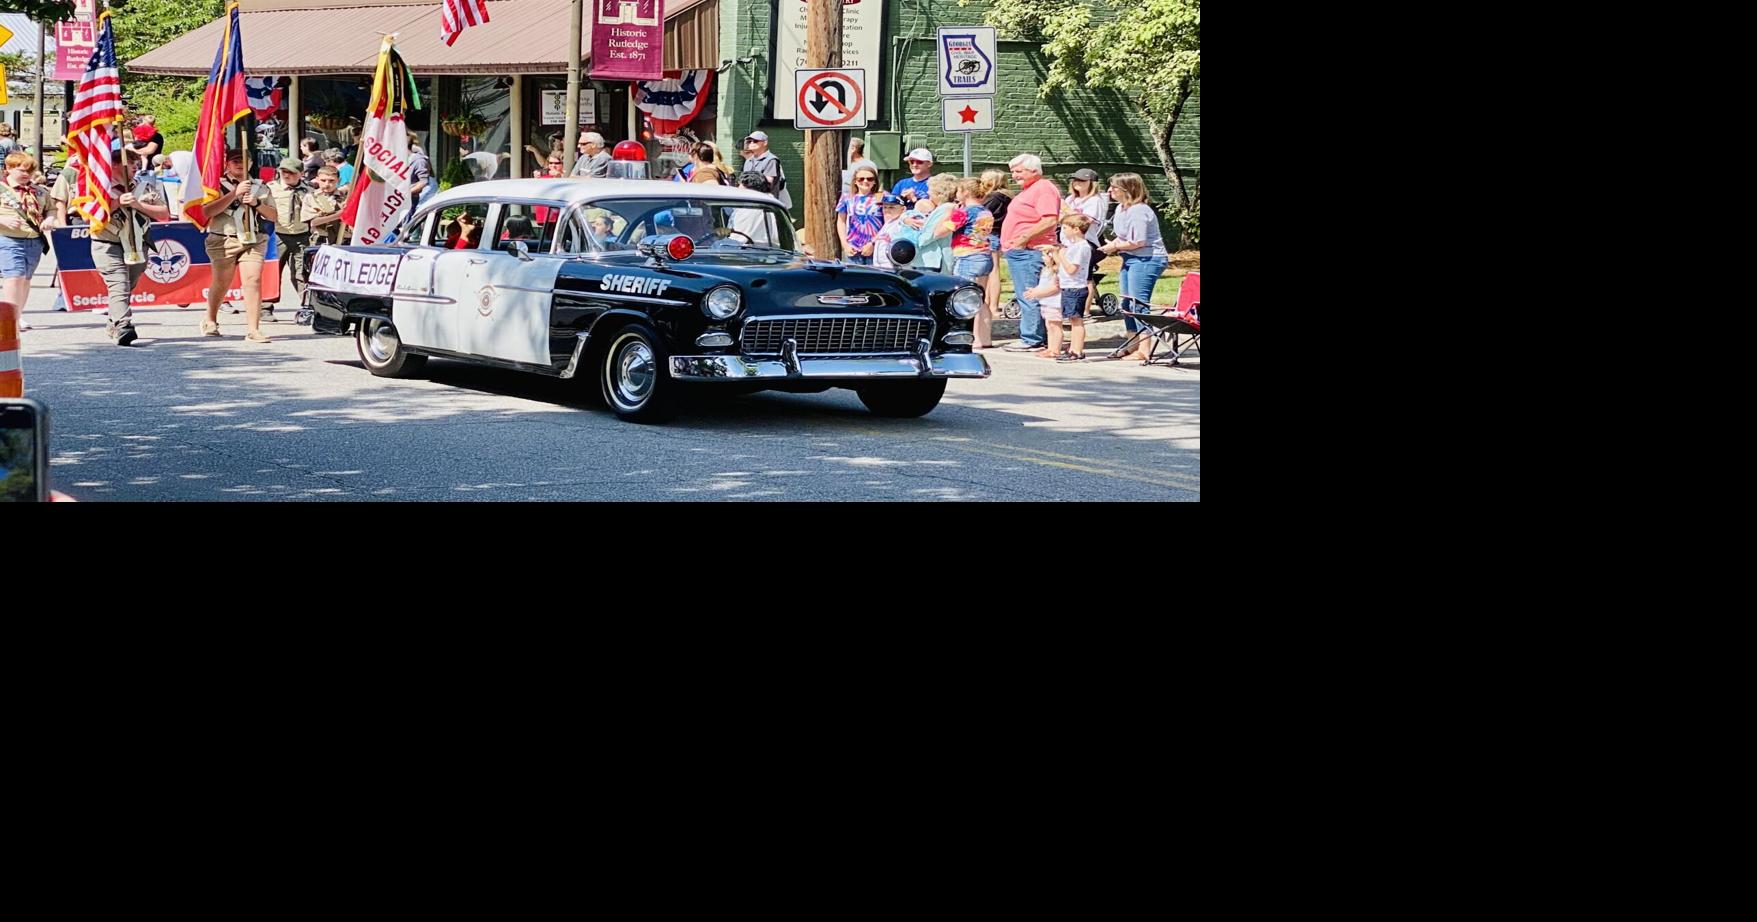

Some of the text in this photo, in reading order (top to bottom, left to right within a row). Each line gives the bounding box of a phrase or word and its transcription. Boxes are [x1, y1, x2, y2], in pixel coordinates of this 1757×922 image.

[611, 27, 648, 38] Historic
[608, 38, 649, 50] Rutledge
[609, 49, 646, 61] Est. 1871
[953, 75, 976, 83] TRAILS
[364, 137, 408, 180] SOCIAL
[71, 228, 89, 239] BO
[600, 273, 672, 296] SHERIFF
[73, 293, 109, 306] Socia
[129, 292, 155, 303] rcle
